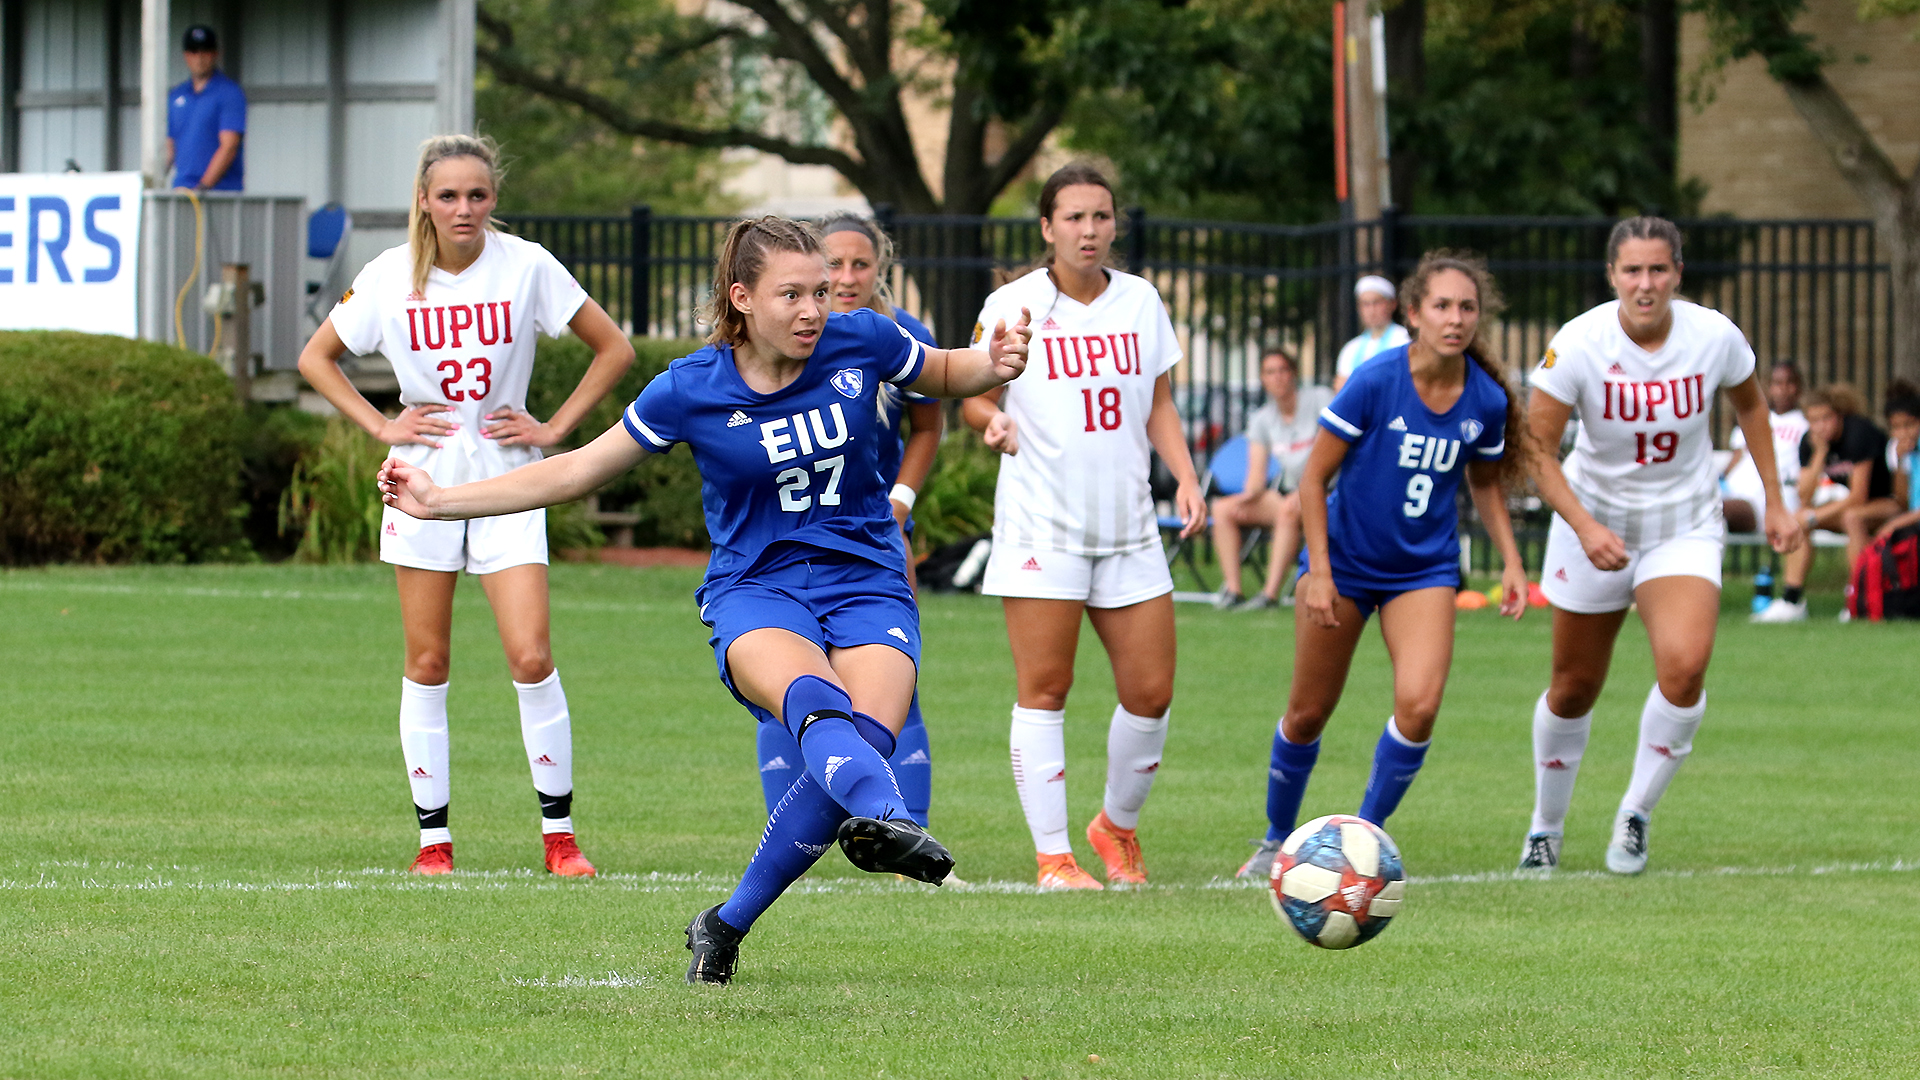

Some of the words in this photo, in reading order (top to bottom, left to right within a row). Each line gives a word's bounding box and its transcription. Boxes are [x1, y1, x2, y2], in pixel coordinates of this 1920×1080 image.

[406, 301, 513, 351] IUPUI
[1042, 332, 1142, 380] IUPUI
[437, 357, 492, 402] 23
[1603, 373, 1705, 422] IUPUI
[1081, 387, 1122, 432] 18
[759, 402, 849, 464] EIU
[1398, 432, 1461, 473] EIU
[1635, 431, 1680, 465] 19
[775, 454, 845, 512] 27
[1403, 473, 1434, 518] 9
